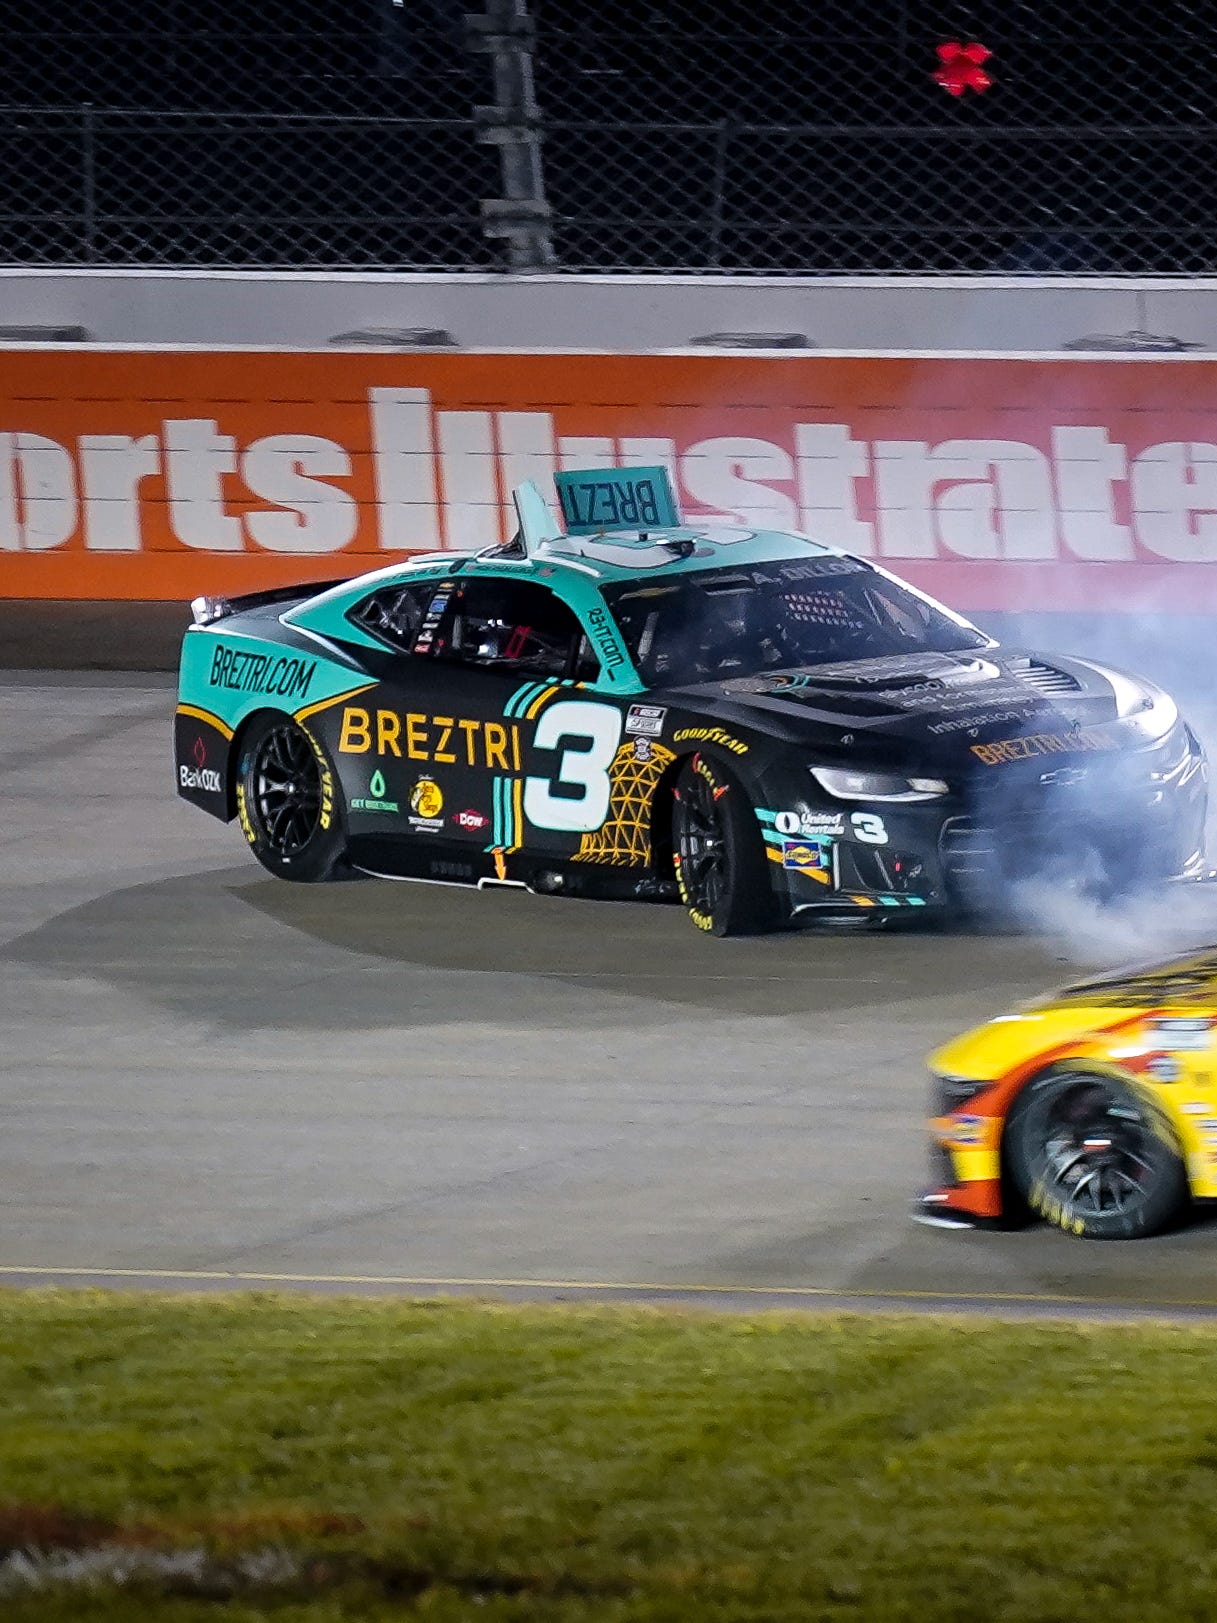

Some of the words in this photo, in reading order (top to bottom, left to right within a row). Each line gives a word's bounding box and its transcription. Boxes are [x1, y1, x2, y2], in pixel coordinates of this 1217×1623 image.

[210, 644, 317, 698] BREZTRI.COM
[338, 707, 521, 771] BREZTRI
[673, 727, 748, 754] GOODYEAR
[524, 701, 622, 832] 3
[801, 813, 843, 825] United
[850, 812, 889, 845] 3
